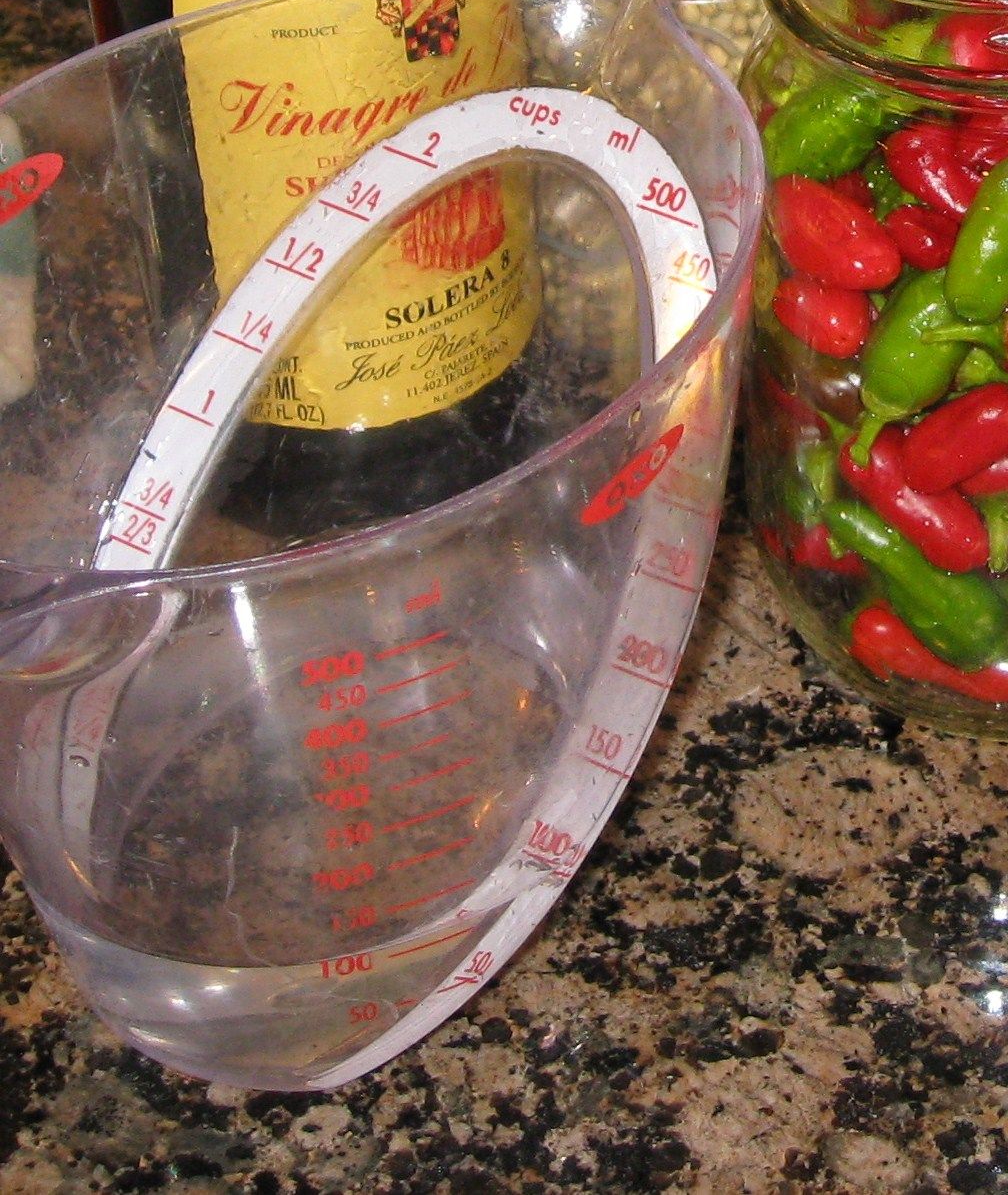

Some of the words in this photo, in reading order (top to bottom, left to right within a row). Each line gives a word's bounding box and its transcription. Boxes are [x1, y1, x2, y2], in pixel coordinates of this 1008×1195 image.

[271, 23, 340, 40] PRODUCT
[508, 95, 562, 127] cups
[422, 131, 441, 158] 2
[606, 126, 642, 154] ml
[345, 179, 381, 212] 3/4
[641, 177, 688, 213] 500
[282, 236, 325, 274] 1/2
[671, 249, 712, 283] 450
[385, 265, 495, 330] SOLERA
[240, 310, 274, 344] 1/4
[345, 330, 415, 352] PRODUCED
[334, 351, 404, 391] José
[201, 389, 217, 415] 1
[275, 403, 294, 421] FL
[297, 403, 326, 427] OZ)
[138, 477, 175, 510] 3/4
[121, 514, 157, 547] 2/3
[320, 952, 373, 979] 100
[349, 1002, 378, 1024] 50
